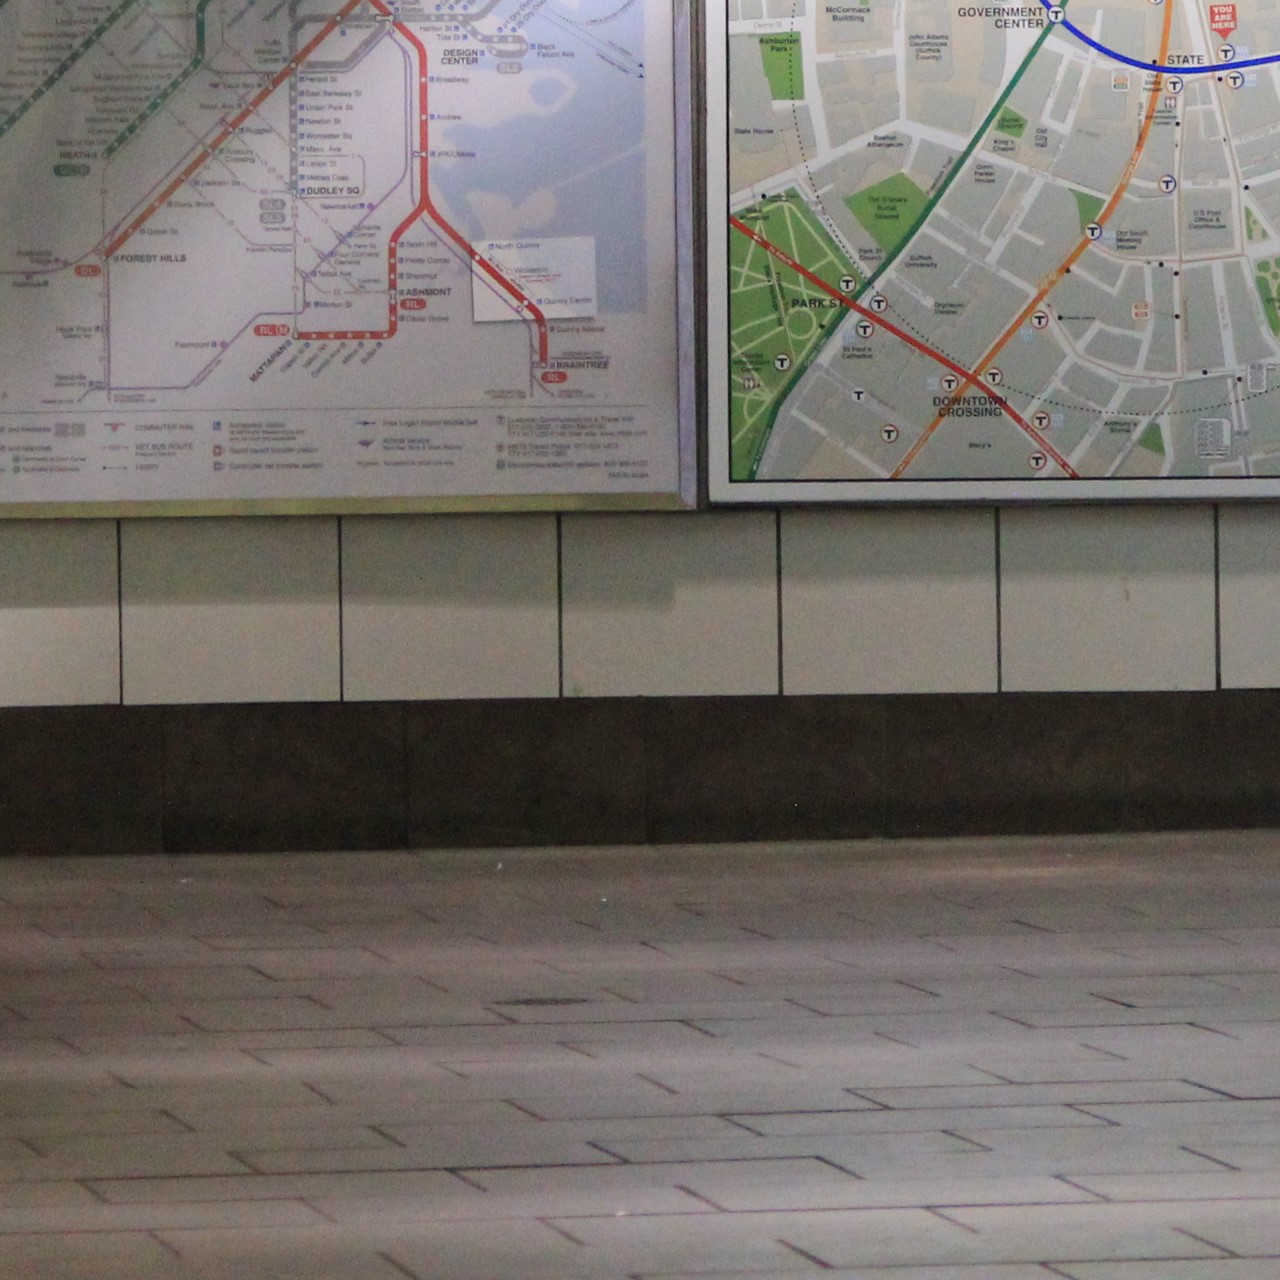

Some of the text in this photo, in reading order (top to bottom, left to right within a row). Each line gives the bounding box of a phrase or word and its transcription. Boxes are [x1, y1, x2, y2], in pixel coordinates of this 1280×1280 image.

[958, 8, 1044, 17] GOVERNMENT
[1213, 6, 1233, 14] YOU
[832, 15, 865, 23] Building
[1214, 14, 1233, 22] ARE
[995, 19, 1044, 29] CENTER
[1212, 22, 1236, 30] HERE
[444, 49, 478, 57] DESIGN
[441, 57, 478, 65] CENTER
[1168, 55, 1205, 65] STATE
[435, 76, 469, 84] Broadway
[307, 187, 360, 195] DUDLEY SQ
[406, 288, 451, 296] ASHMONT
[544, 297, 568, 305] Quincy
[792, 299, 826, 309] PARK
[249, 344, 287, 383] MATTAPAN
[557, 361, 609, 369] BRAINTREE
[933, 397, 1008, 407] DOWNTOWN
[938, 407, 1003, 417] CROSSING
